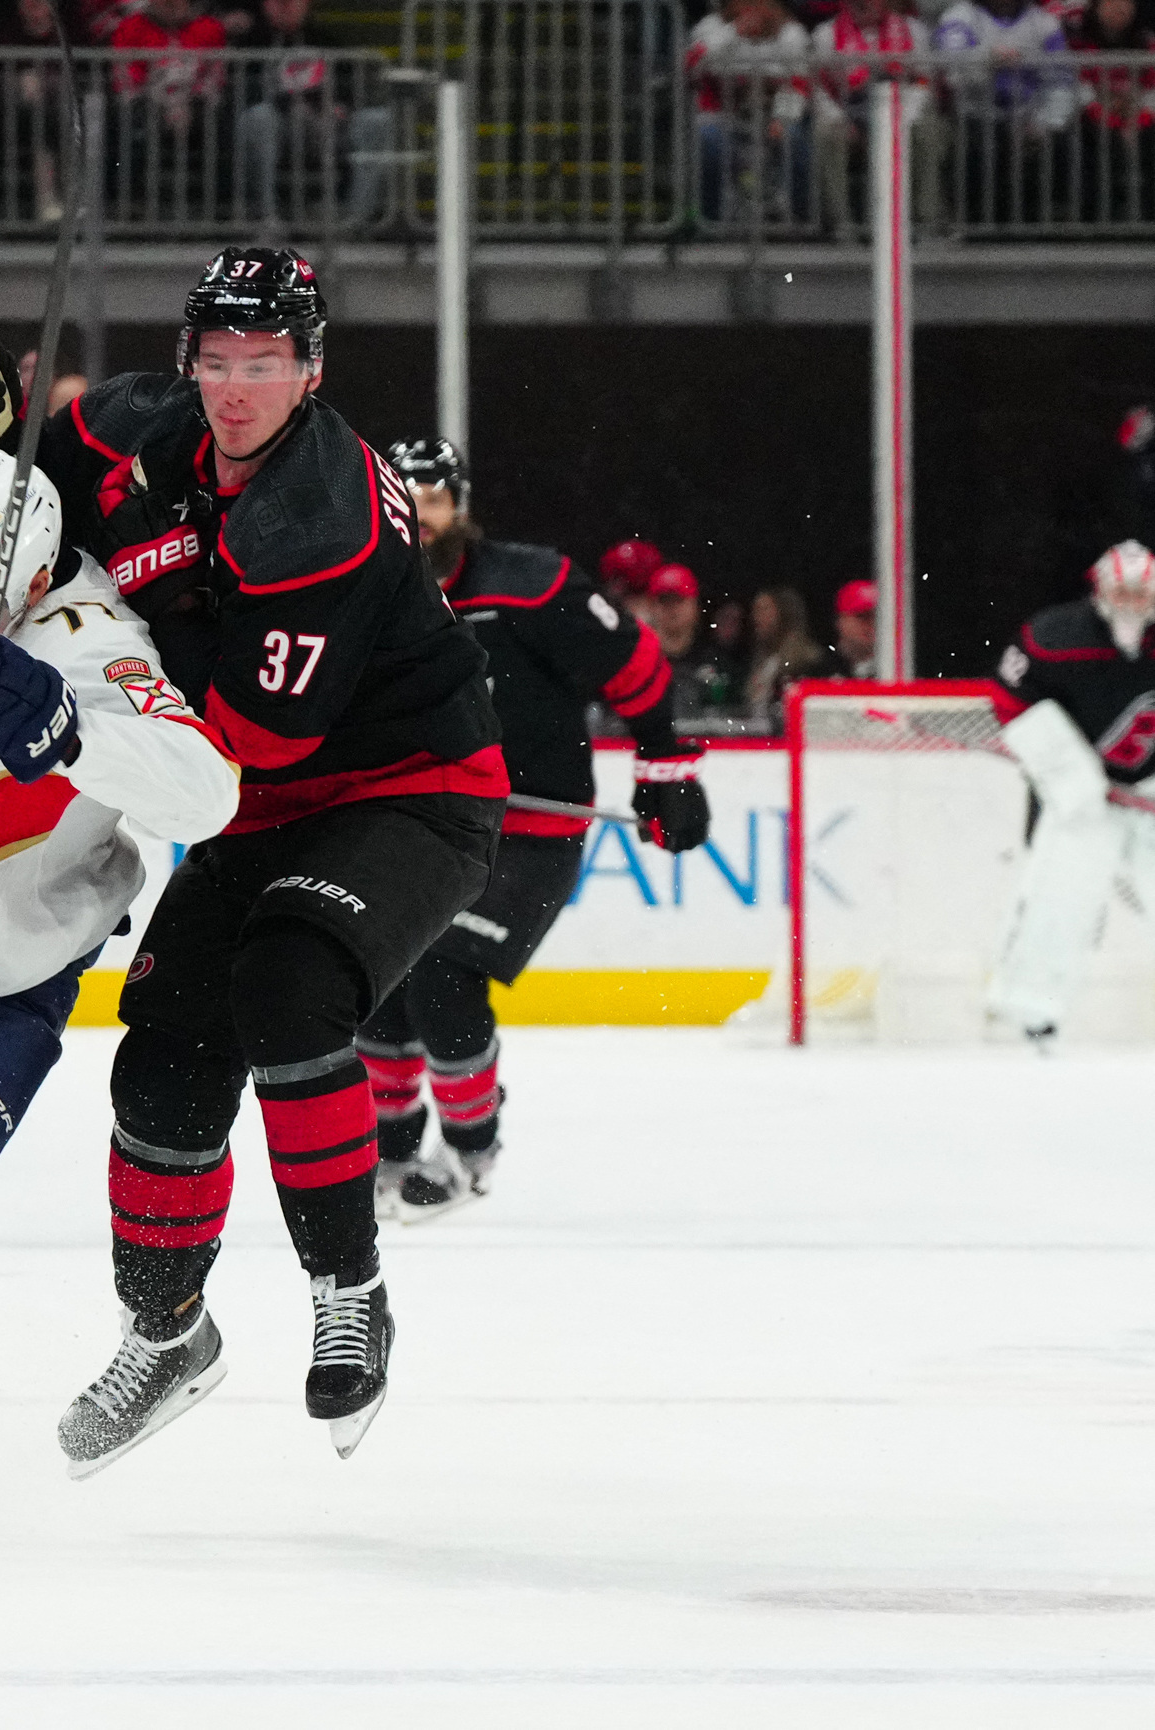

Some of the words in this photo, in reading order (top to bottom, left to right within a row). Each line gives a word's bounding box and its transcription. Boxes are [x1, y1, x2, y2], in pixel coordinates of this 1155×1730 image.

[230, 260, 263, 278] 37
[374, 451, 411, 546] SVE
[110, 661, 145, 677] PANTHERS
[258, 628, 327, 696] 37
[26, 680, 76, 758] UER
[565, 808, 855, 908] ANK
